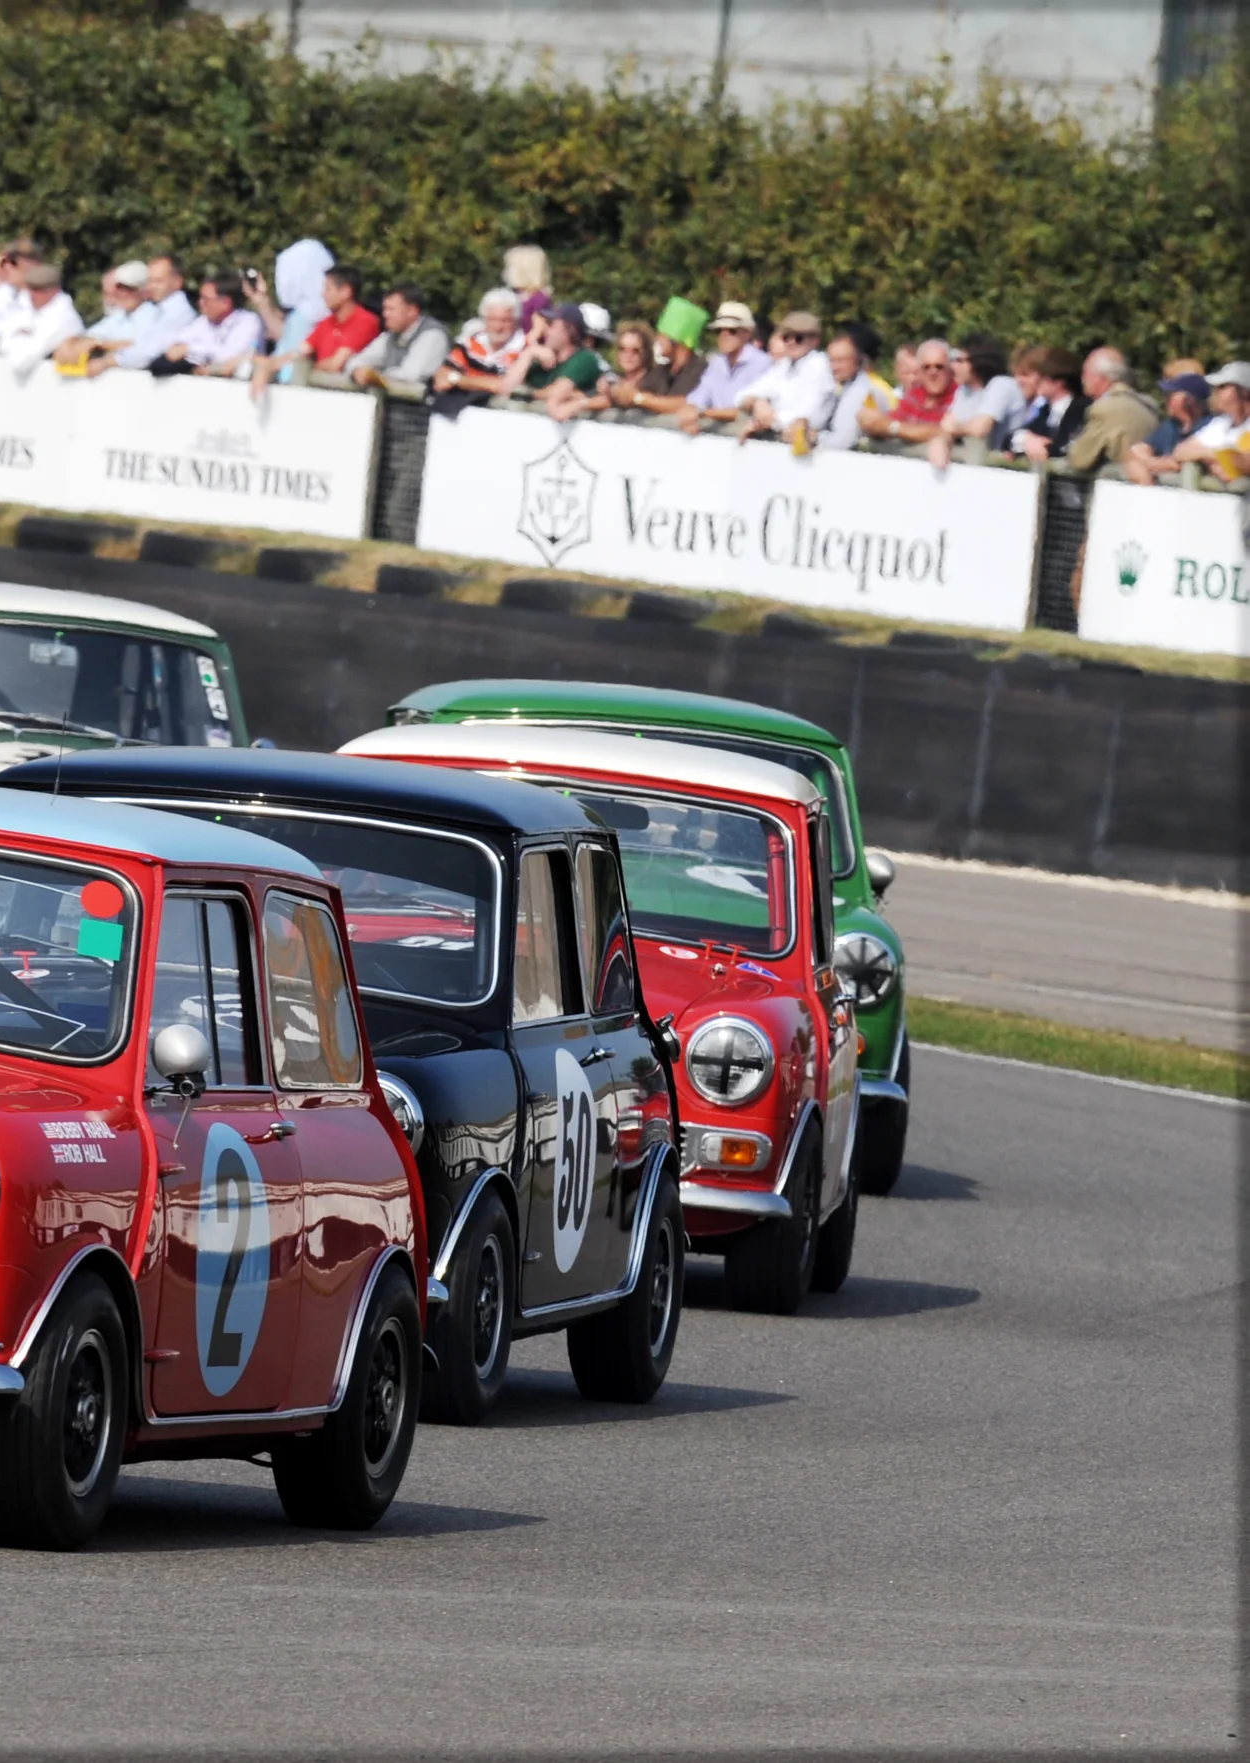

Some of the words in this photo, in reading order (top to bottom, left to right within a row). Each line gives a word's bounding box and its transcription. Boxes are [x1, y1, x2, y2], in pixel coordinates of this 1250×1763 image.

[103, 446, 154, 482] THE
[158, 455, 254, 495] SUNDAY
[260, 465, 333, 505] TIMES
[622, 474, 747, 559] Veuve
[760, 493, 950, 592] Clicquot
[82, 1144, 107, 1163] HALL
[557, 1090, 592, 1232] 50
[206, 1148, 250, 1367] 2
